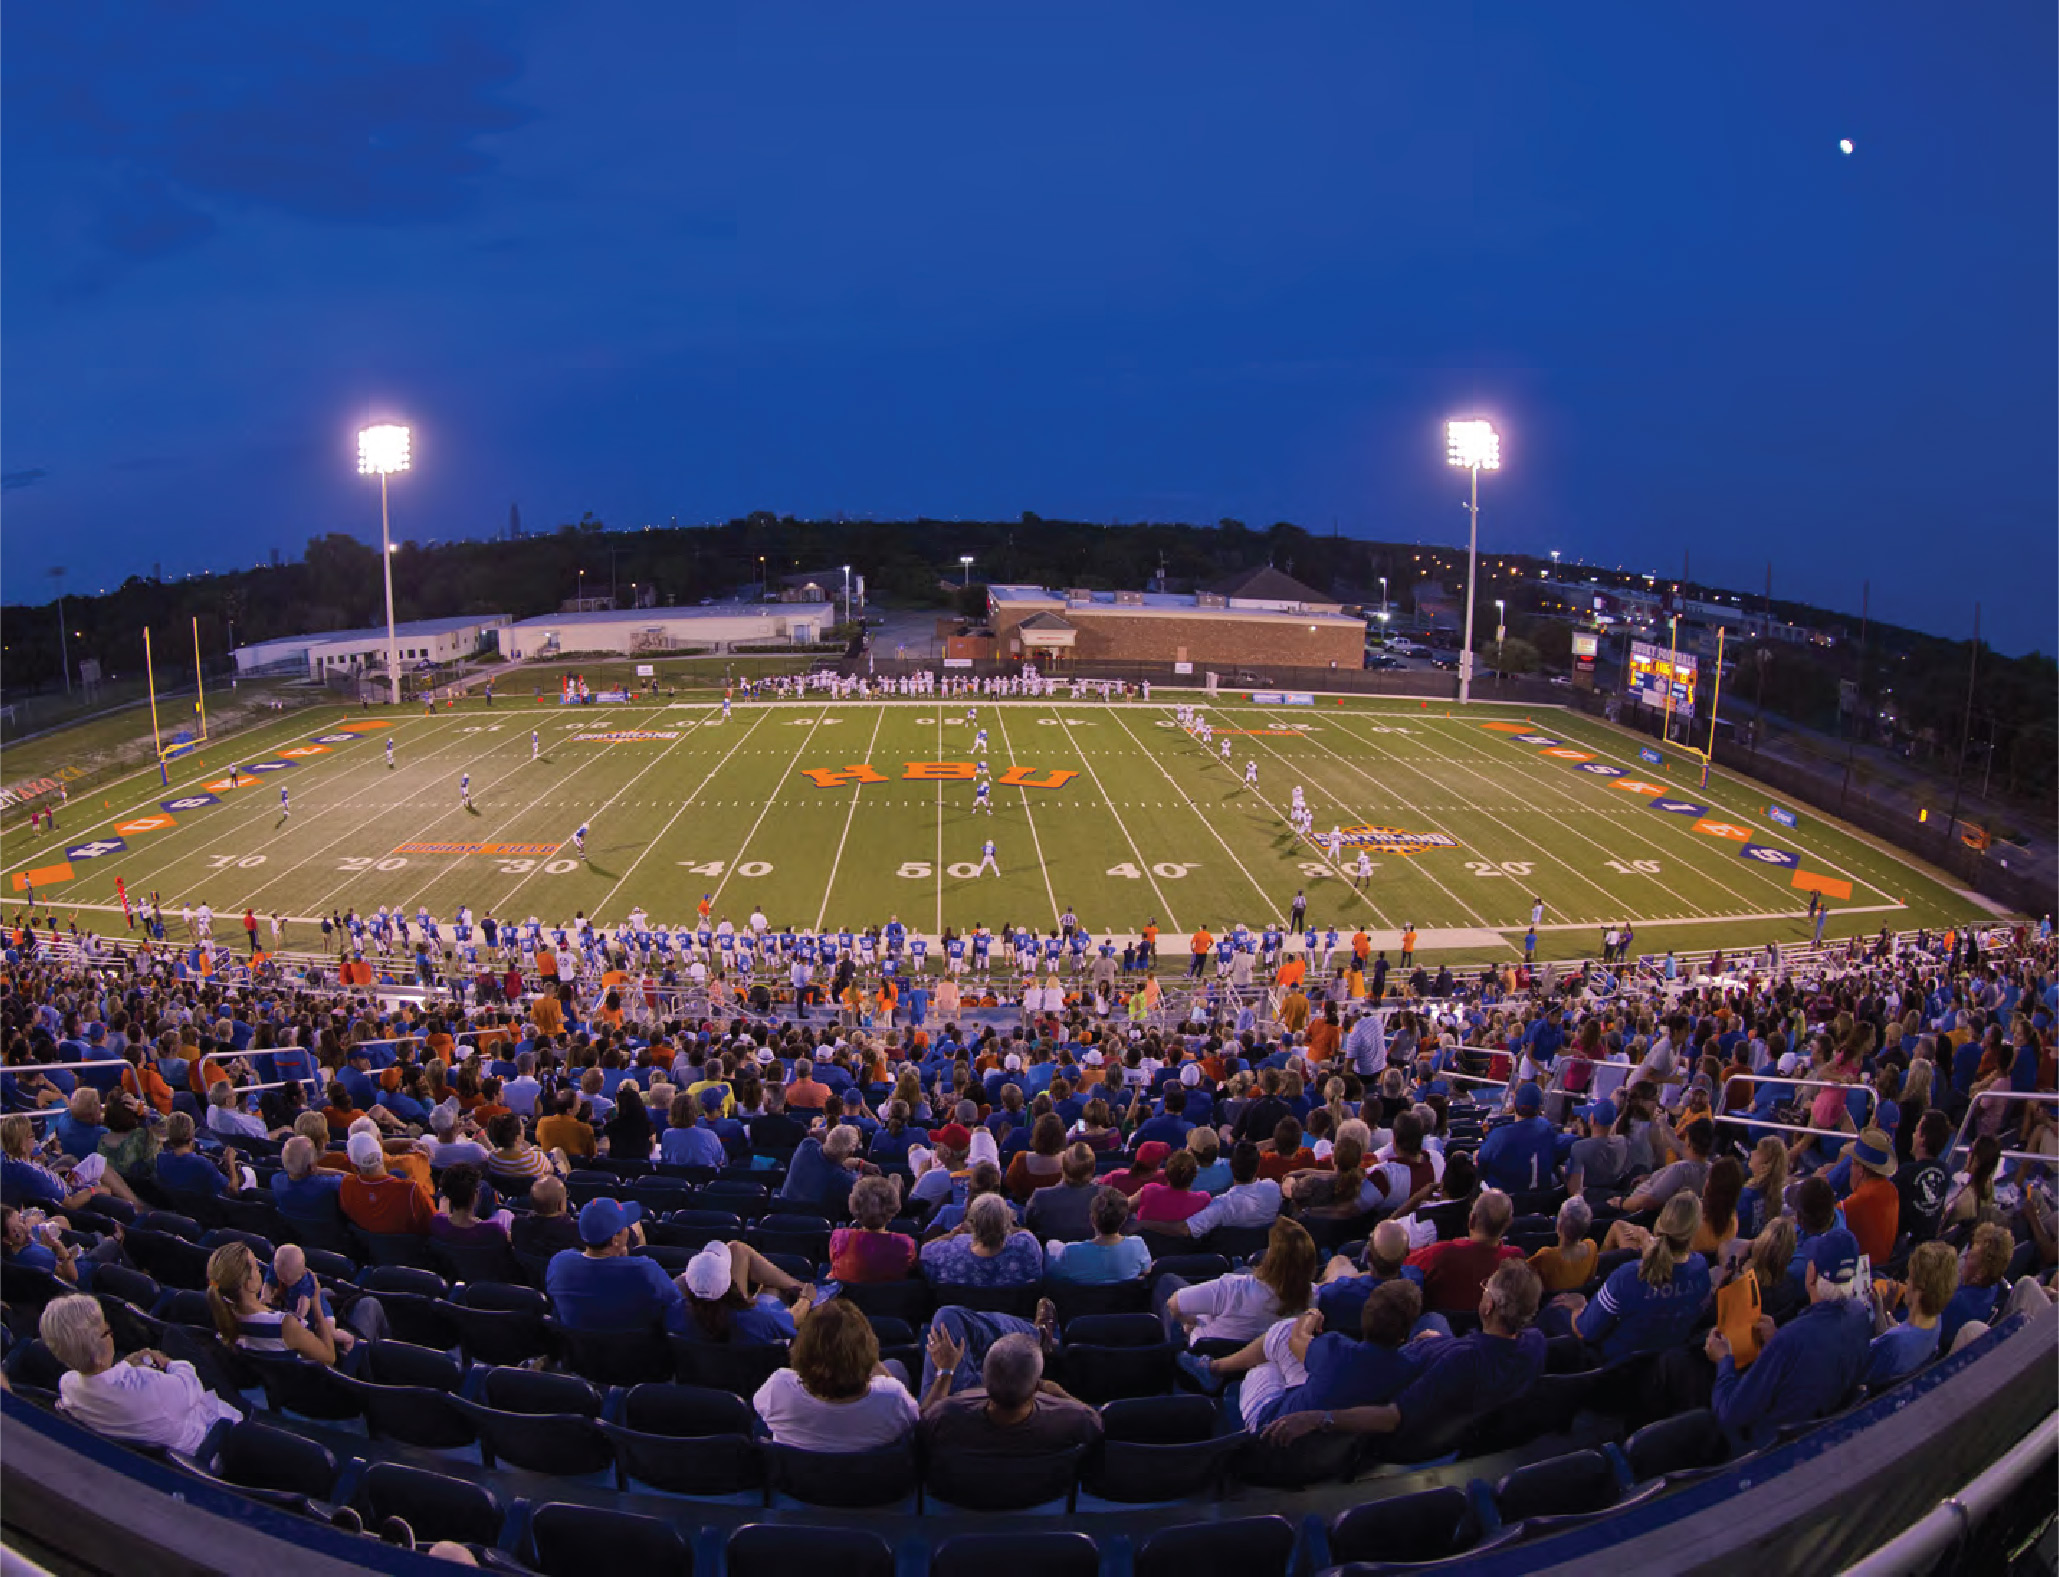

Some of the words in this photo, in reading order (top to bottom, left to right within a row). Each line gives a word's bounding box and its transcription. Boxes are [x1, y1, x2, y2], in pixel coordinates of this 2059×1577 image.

[801, 762, 1080, 788] HBU
[206, 855, 267, 869] 10
[337, 857, 407, 871] 20
[500, 859, 578, 874] 30
[689, 862, 774, 877] 40
[1465, 862, 1532, 876] 20
[896, 862, 981, 878] 50
[1106, 862, 1188, 878] 40
